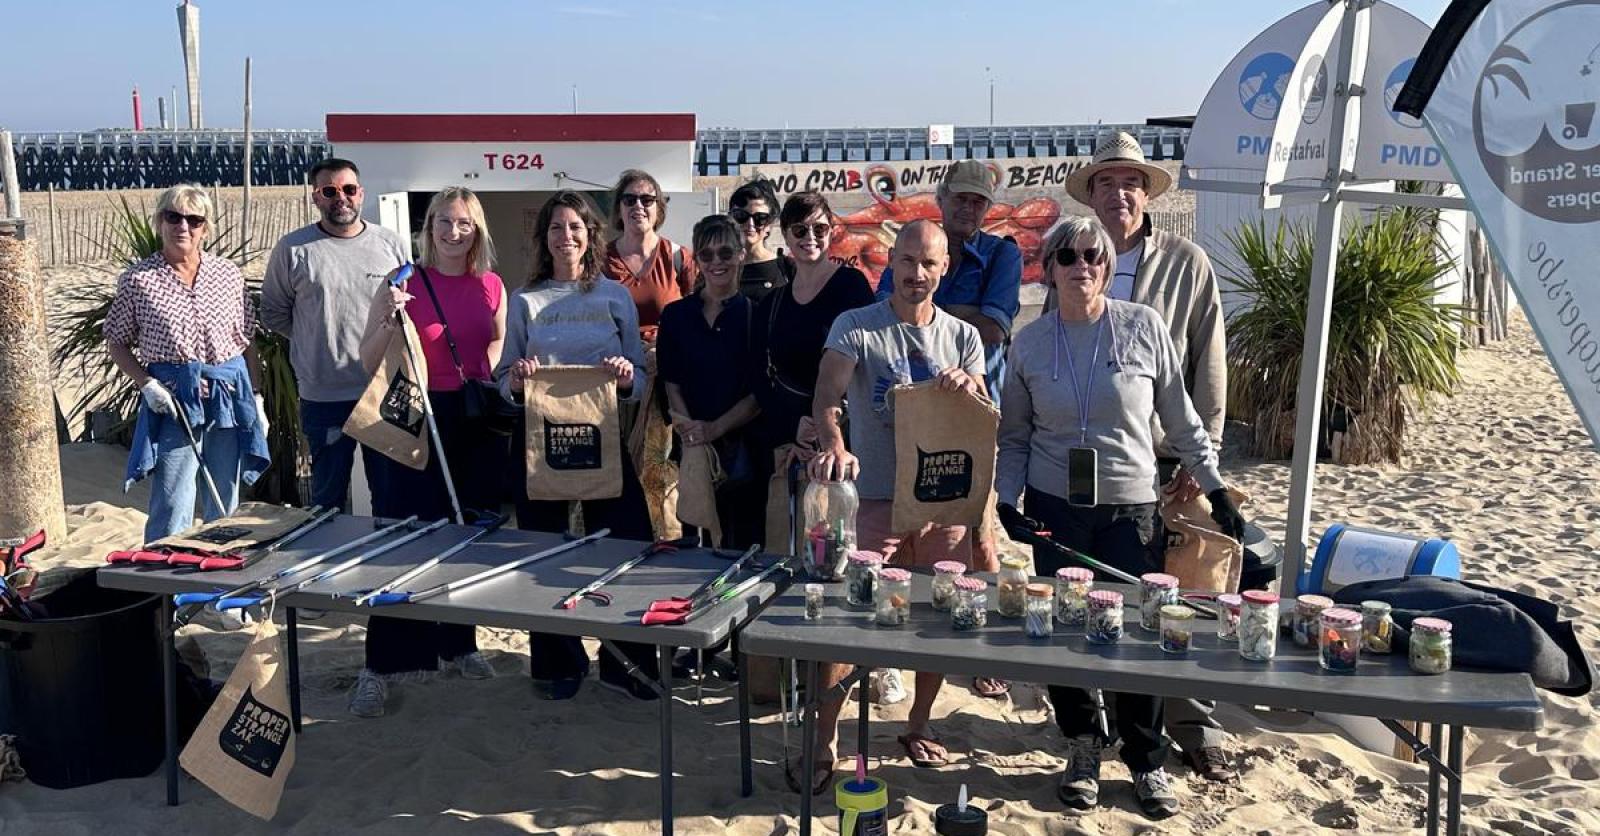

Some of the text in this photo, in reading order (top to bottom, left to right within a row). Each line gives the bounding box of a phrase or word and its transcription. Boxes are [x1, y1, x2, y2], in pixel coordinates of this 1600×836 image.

[1236, 135, 1272, 155] PM
[1273, 138, 1326, 163] Restafval
[483, 153, 545, 170] T 624
[1380, 142, 1441, 168] PMD
[804, 168, 864, 193] CRAB
[900, 166, 925, 187] ON
[550, 426, 593, 437] PROPER
[551, 436, 595, 446] STRANGE
[551, 446, 570, 455] ZAK
[923, 454, 965, 469] PROPER
[922, 465, 966, 478] STRANGE
[920, 476, 940, 487] ZAK
[243, 701, 289, 735] PROPER
[231, 722, 257, 744] ZAK
[238, 714, 284, 746] STRANGE
